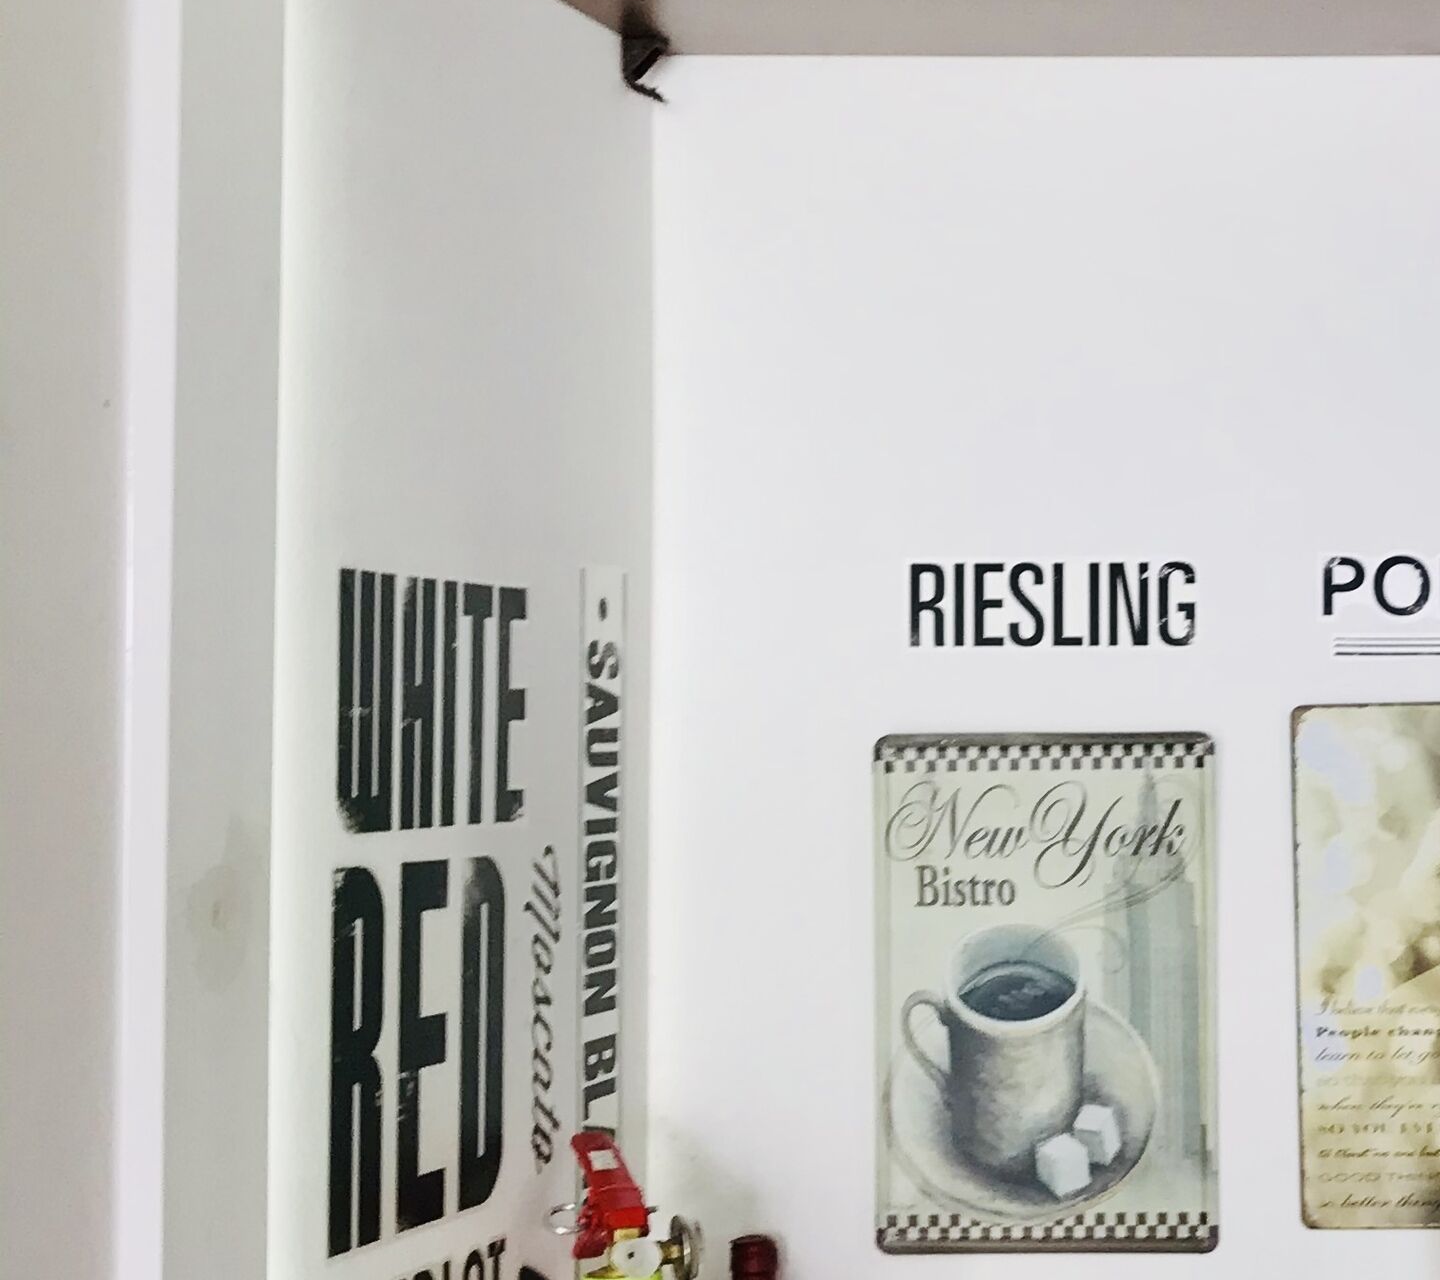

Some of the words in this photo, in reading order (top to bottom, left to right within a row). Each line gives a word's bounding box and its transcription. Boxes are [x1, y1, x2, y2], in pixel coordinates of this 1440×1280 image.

[909, 562, 1197, 647] RIESLING
[336, 567, 527, 834] WHITE
[583, 639, 619, 1017] SAUVIGNON
[885, 780, 1030, 861] New
[1029, 780, 1188, 890] York
[914, 865, 1017, 907] Bistro
[327, 855, 505, 1258] RED
[1315, 1025, 1381, 1040] People
[1340, 1193, 1391, 1208] better
